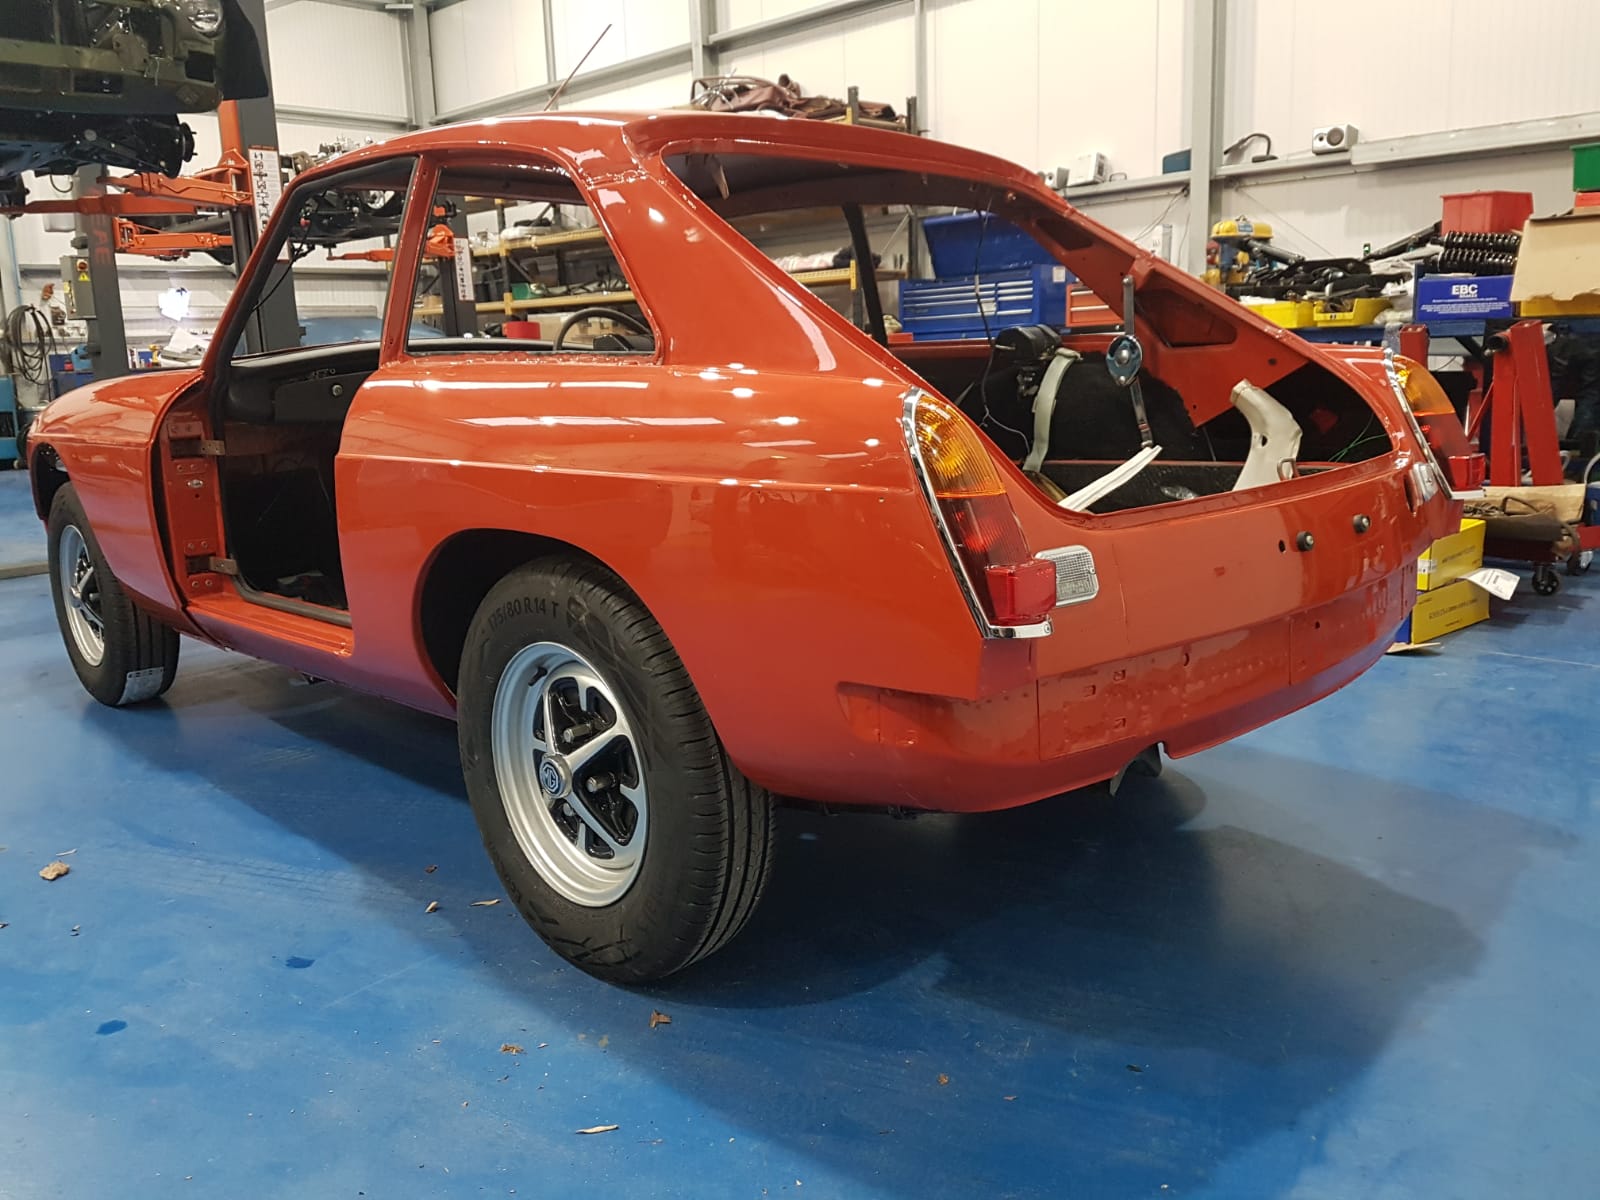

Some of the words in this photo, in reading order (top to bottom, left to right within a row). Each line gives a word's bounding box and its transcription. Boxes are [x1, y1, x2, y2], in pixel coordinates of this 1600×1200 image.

[1451, 284, 1478, 295] EBC
[551, 601, 559, 618] T
[541, 765, 557, 790] MG
